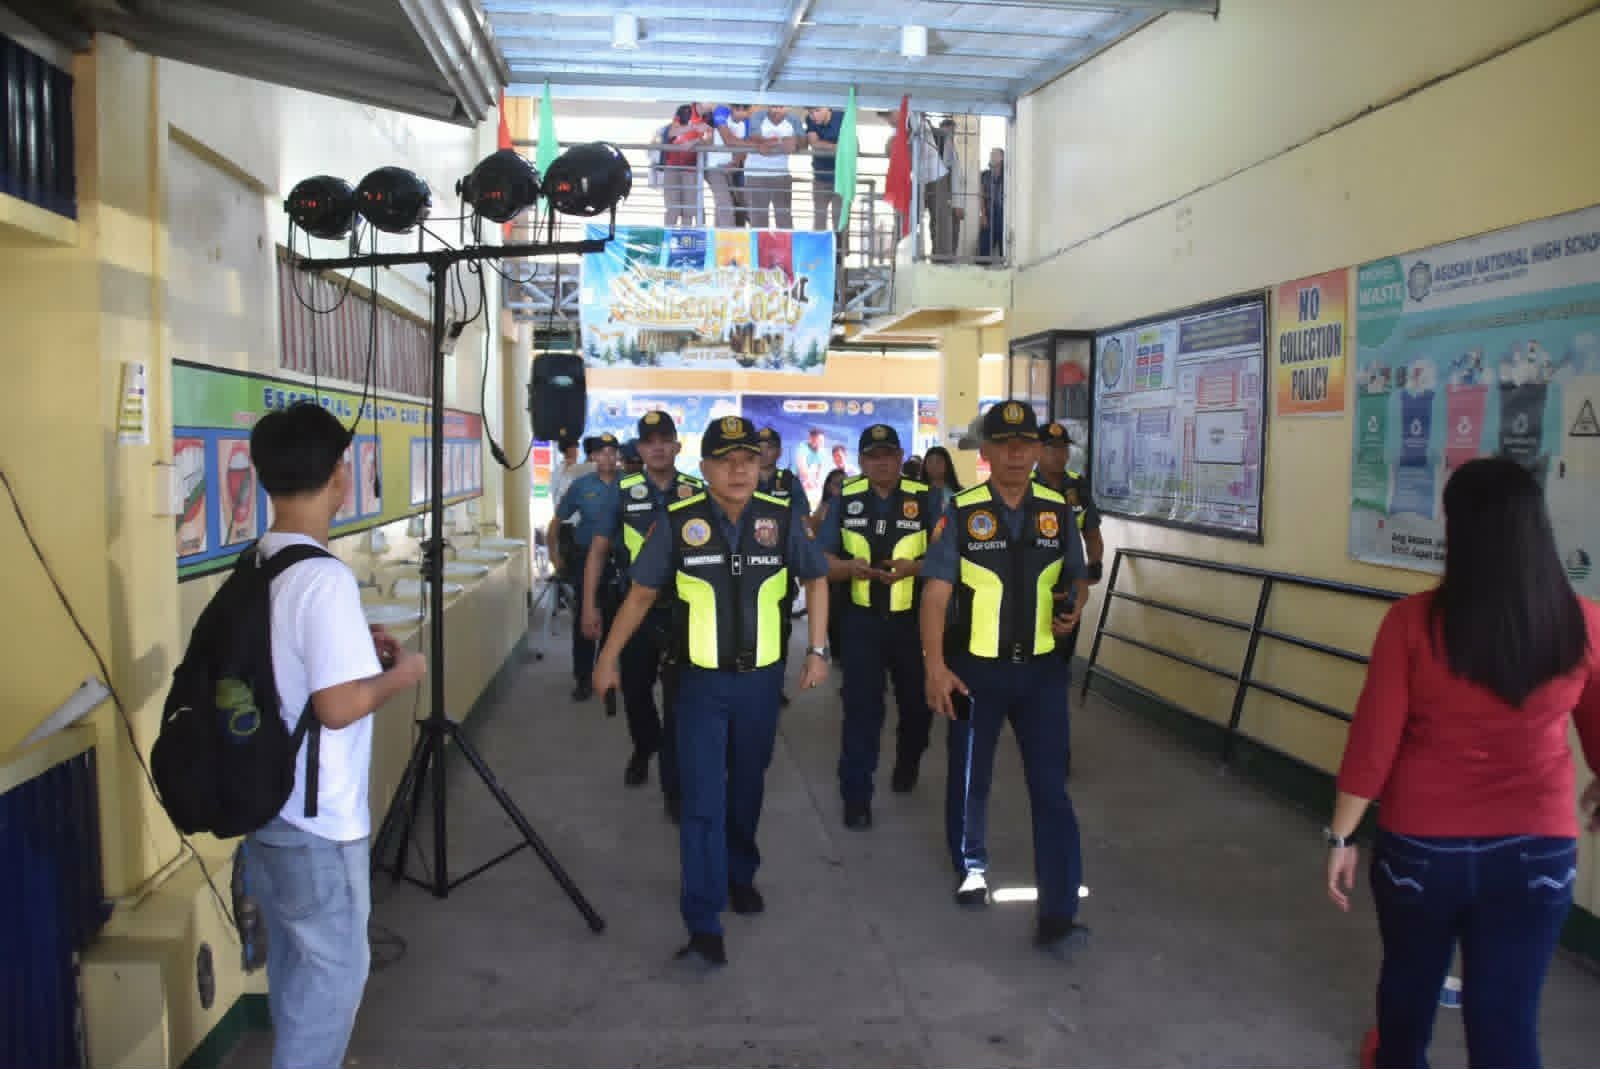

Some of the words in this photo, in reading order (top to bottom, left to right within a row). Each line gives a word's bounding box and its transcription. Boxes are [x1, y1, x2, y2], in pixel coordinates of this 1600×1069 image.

[1434, 259, 1473, 281] AGUSAN
[1475, 248, 1528, 273] NATIONAL
[1531, 240, 1561, 264] HIGH
[1298, 286, 1320, 322] NO
[1280, 323, 1341, 365] COLLECTION
[1291, 367, 1328, 401] POLICY
[967, 540, 1007, 551] GOFORTH
